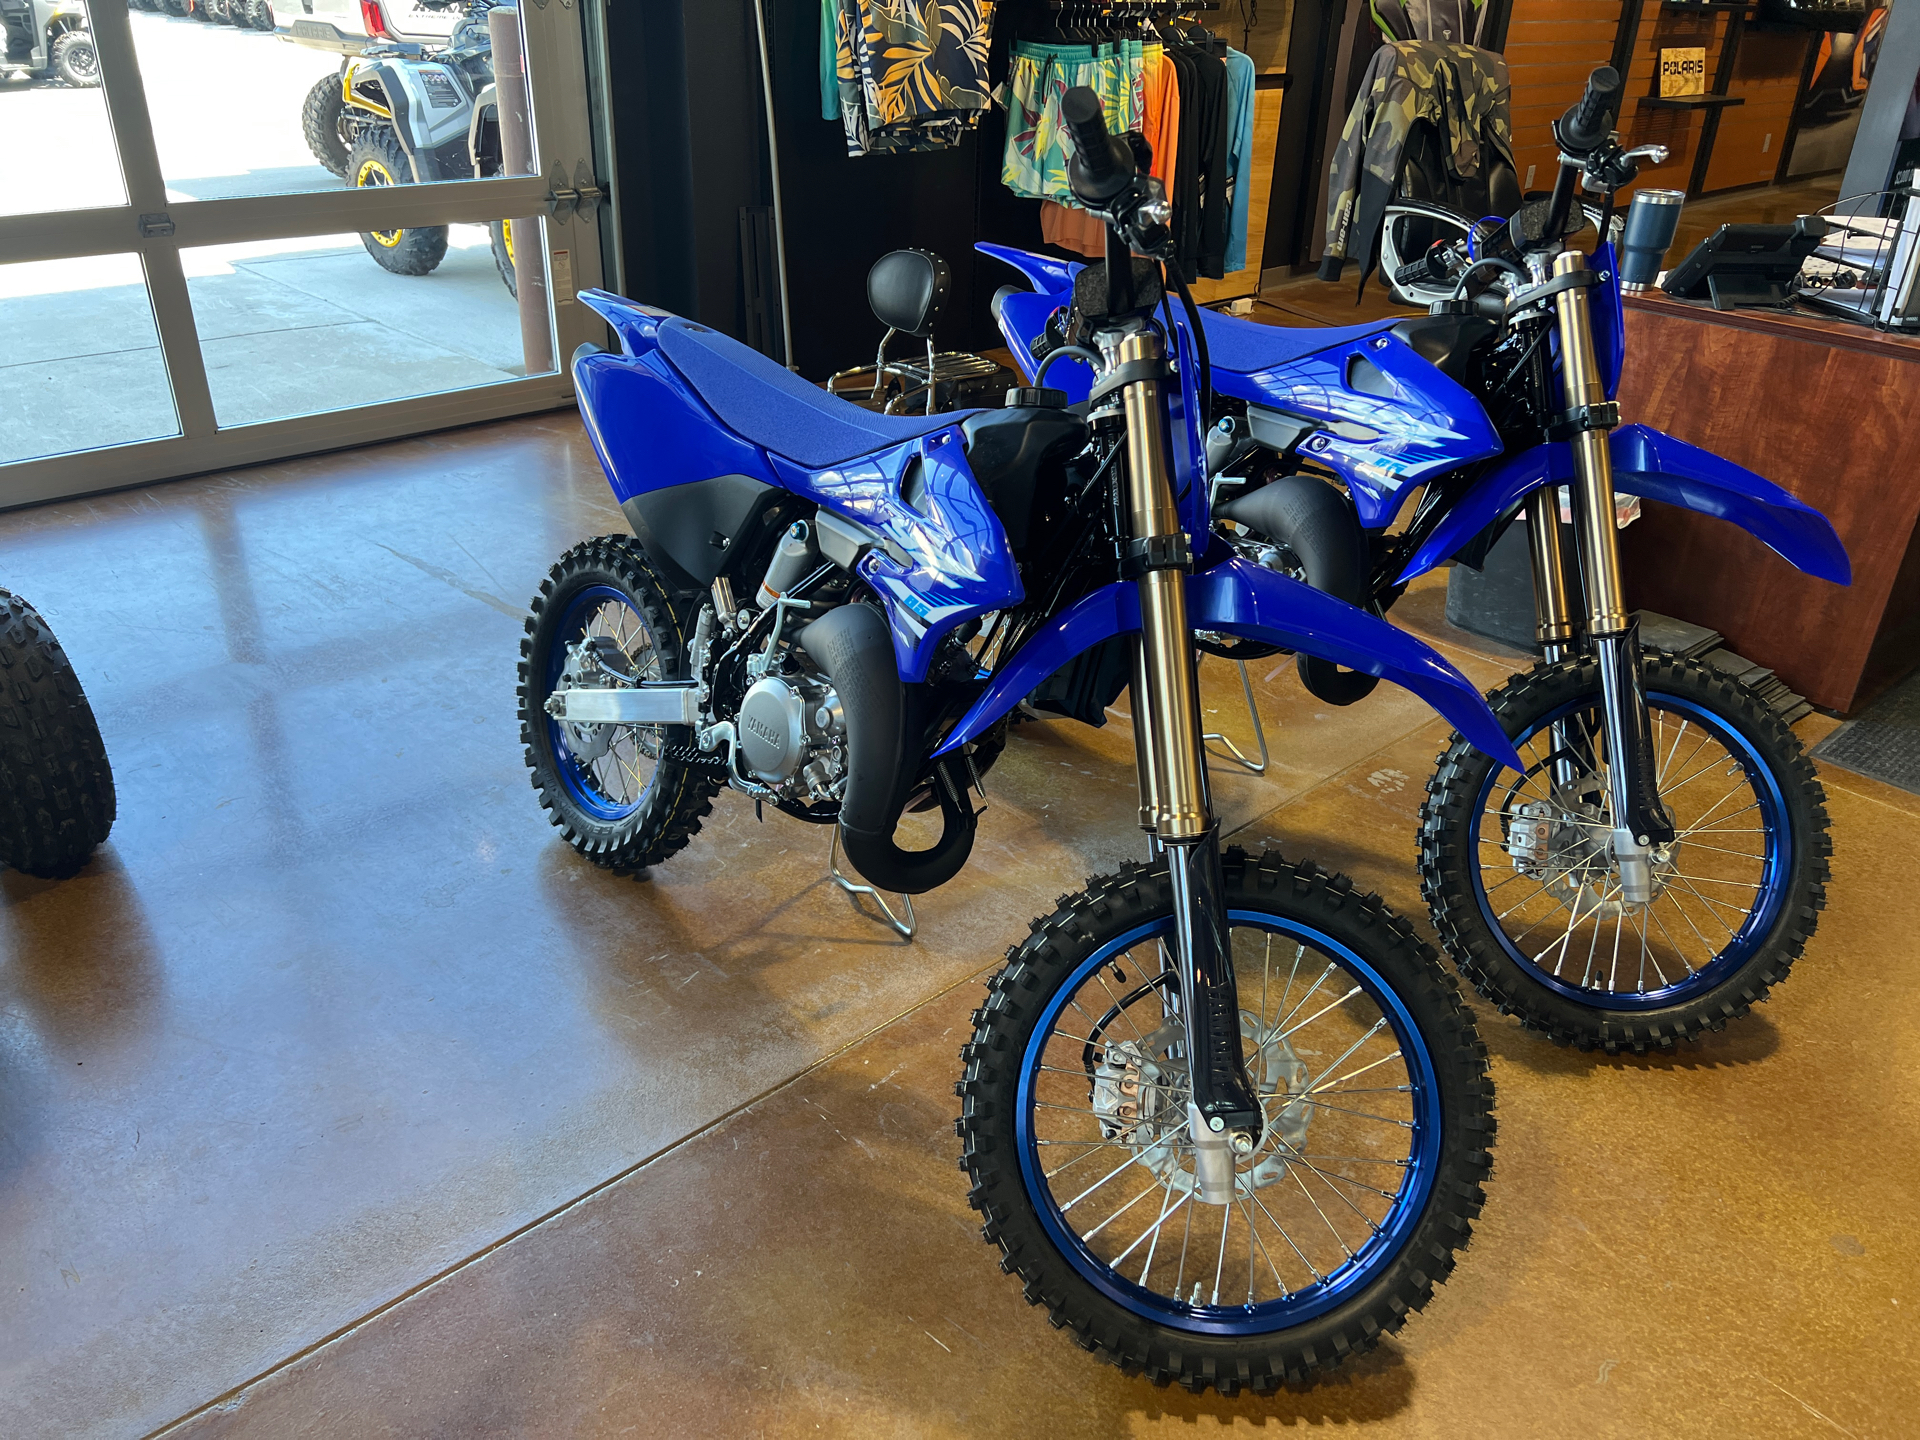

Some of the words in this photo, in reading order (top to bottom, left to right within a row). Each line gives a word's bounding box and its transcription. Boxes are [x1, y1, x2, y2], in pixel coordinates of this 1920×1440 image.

[1662, 60, 1704, 75] POLARIS
[1337, 199, 1352, 251] can-am
[903, 594, 931, 618] 85
[747, 714, 781, 750] YAMAHA
[1206, 981, 1237, 1085] YAMAHA
